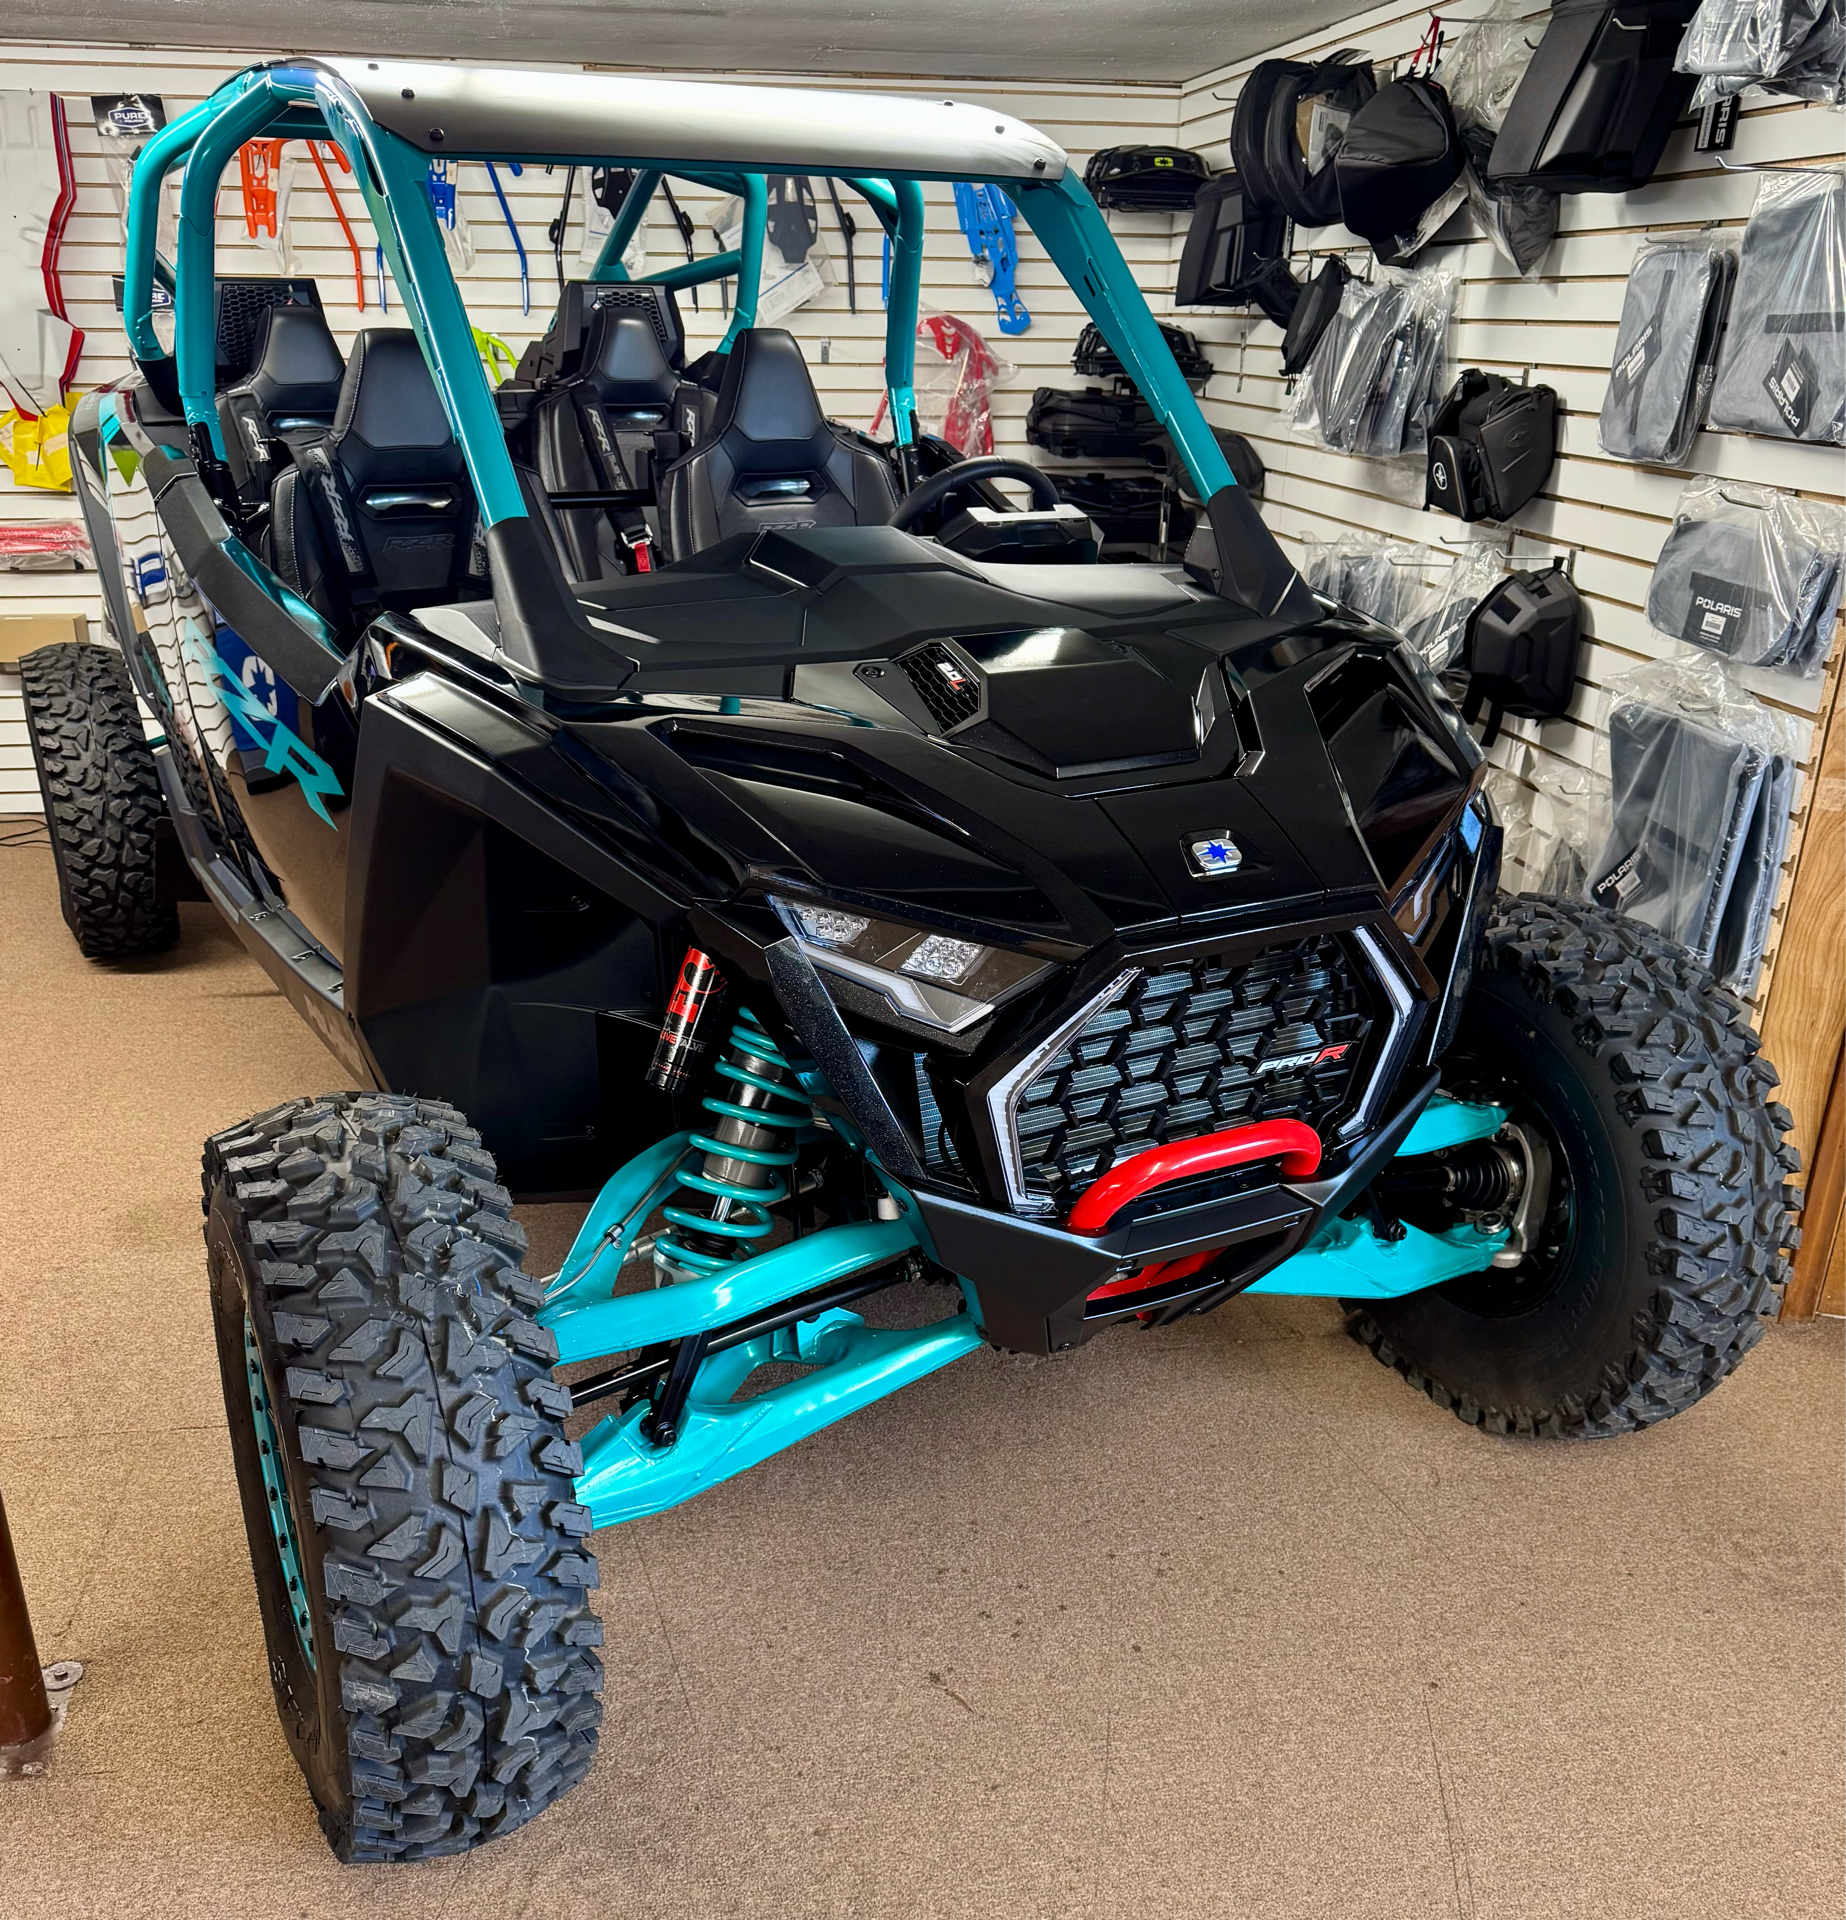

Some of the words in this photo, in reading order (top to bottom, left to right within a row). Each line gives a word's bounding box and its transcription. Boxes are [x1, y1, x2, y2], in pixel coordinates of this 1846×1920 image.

[113, 112, 148, 120] PURE
[1615, 324, 1653, 378] POLARIS
[1768, 376, 1801, 428] POLARIS
[587, 408, 611, 452] RZR
[382, 533, 457, 553] RZR
[1695, 596, 1742, 618] POLARIS
[1418, 622, 1459, 657] POLARIS
[184, 613, 346, 832] RZR
[1596, 851, 1641, 894] POLARIS
